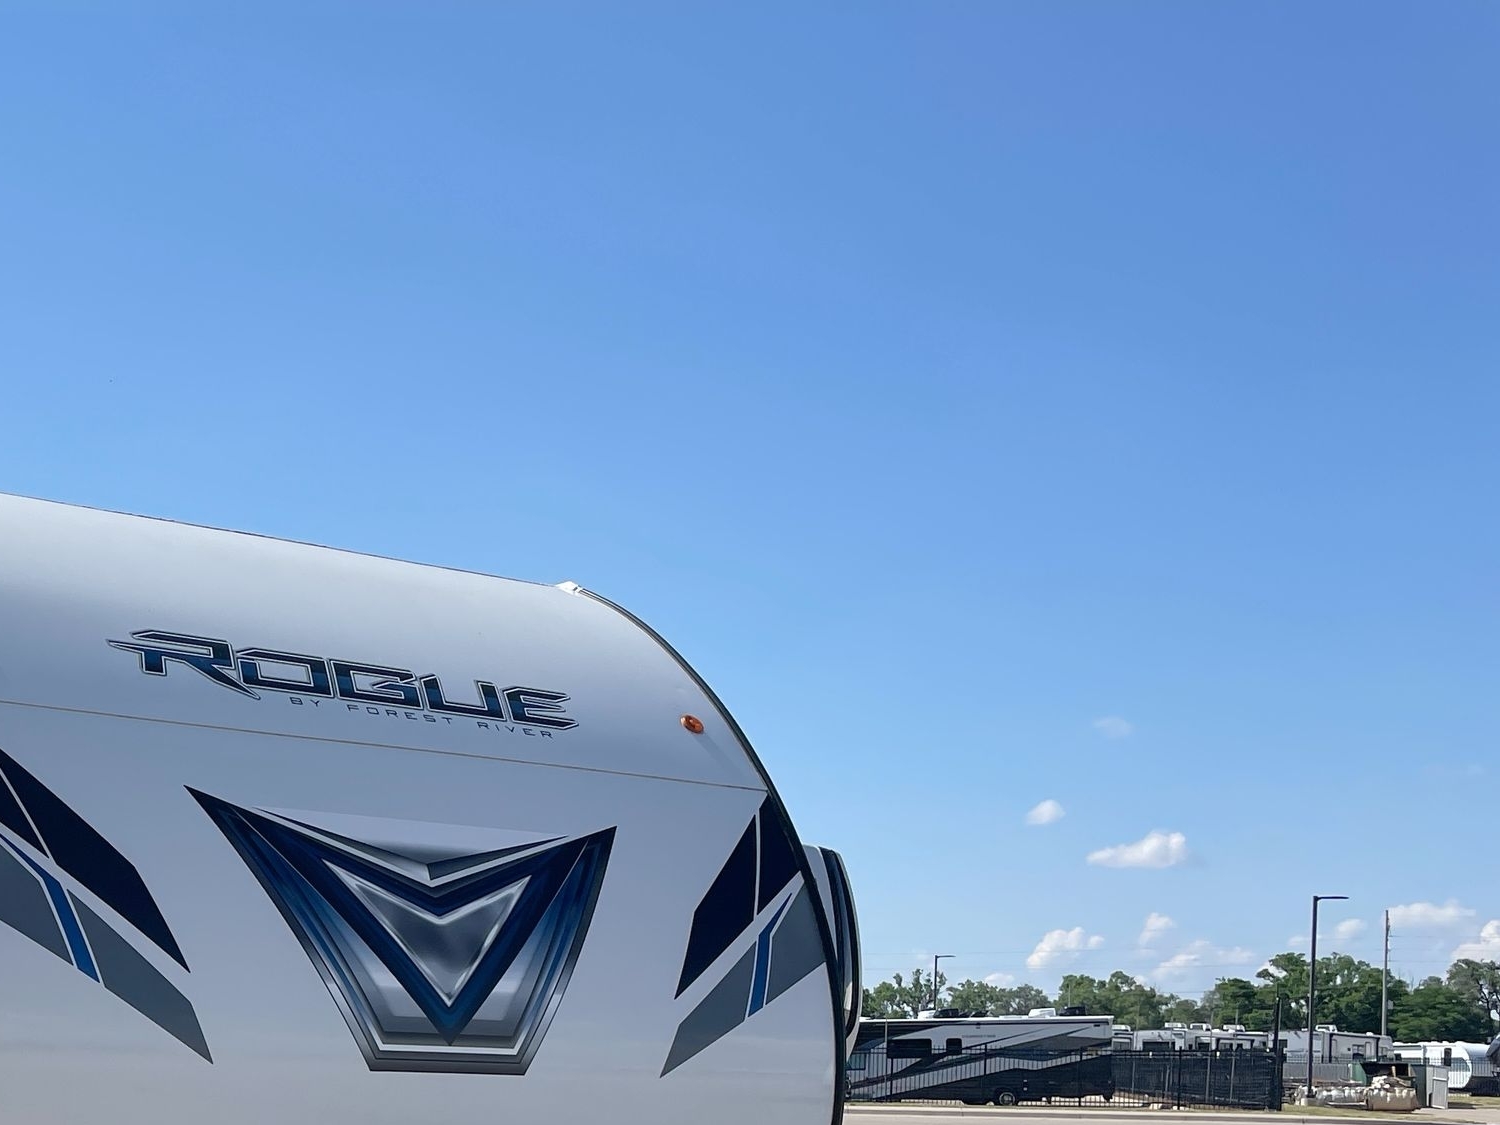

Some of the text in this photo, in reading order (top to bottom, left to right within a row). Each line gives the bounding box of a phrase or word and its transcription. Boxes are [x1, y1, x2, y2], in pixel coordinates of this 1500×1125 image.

[106, 629, 580, 731] ROGUE
[289, 696, 555, 739] BY FOREST RIVER
